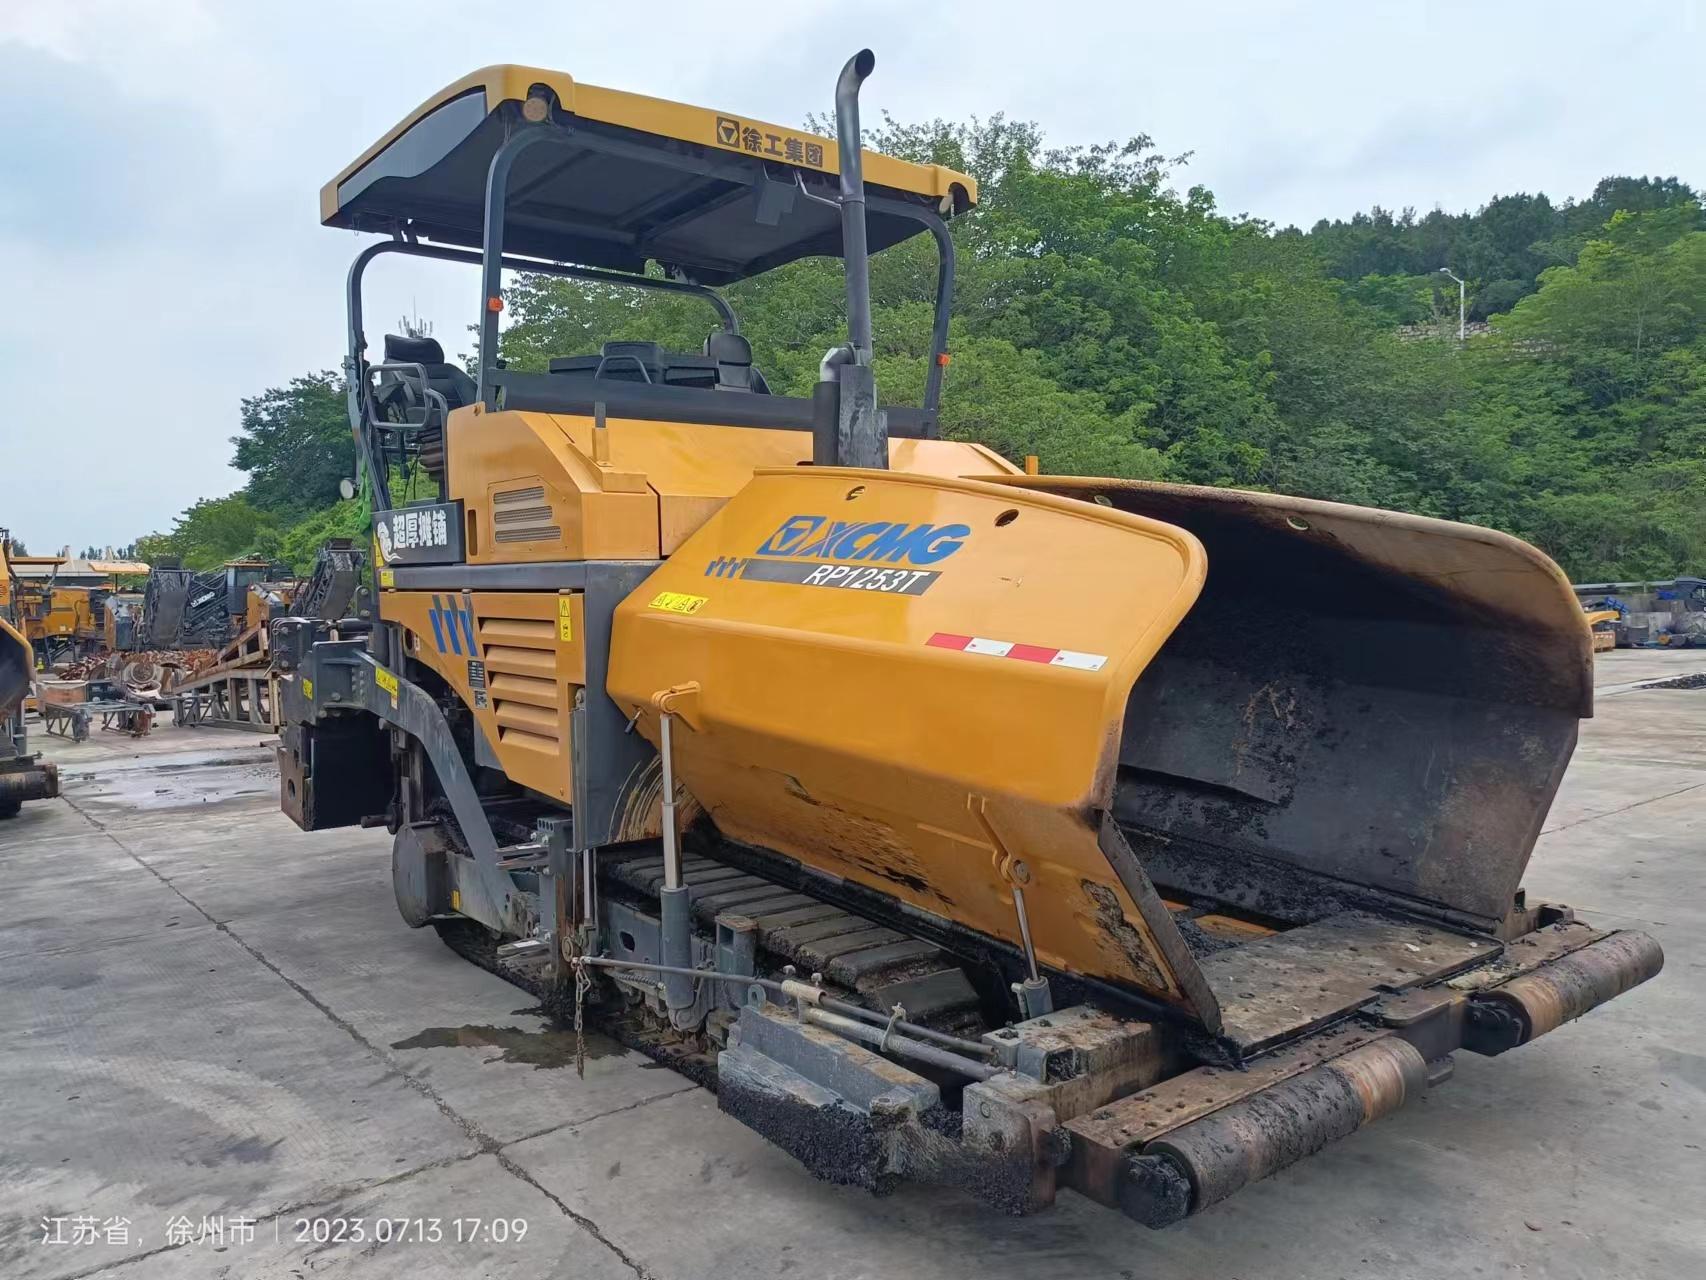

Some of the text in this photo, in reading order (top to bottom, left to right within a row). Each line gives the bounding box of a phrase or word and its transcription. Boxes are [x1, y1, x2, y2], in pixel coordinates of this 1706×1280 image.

[742, 126, 823, 168] 徐工集团
[792, 522, 971, 565] XCMG
[802, 564, 931, 593] RP1253T
